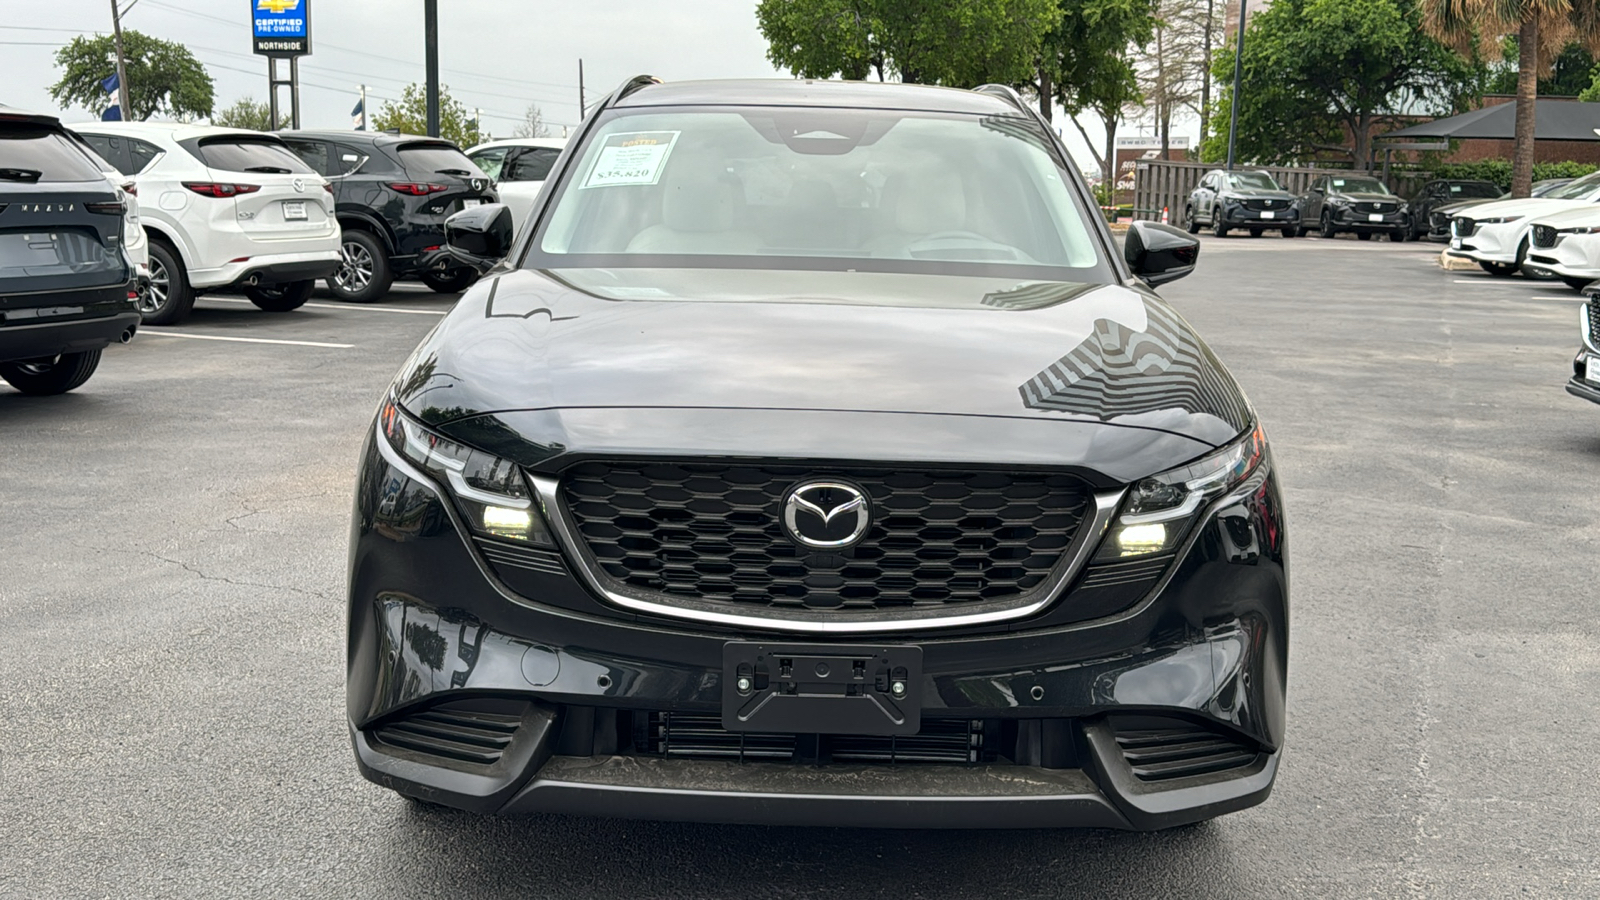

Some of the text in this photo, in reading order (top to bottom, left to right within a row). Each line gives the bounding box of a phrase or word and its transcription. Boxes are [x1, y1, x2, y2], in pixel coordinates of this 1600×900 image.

[255, 18, 303, 26] CERTIFIED
[258, 41, 301, 50] NORTHSIDE
[21, 204, 75, 212] MAZDA
